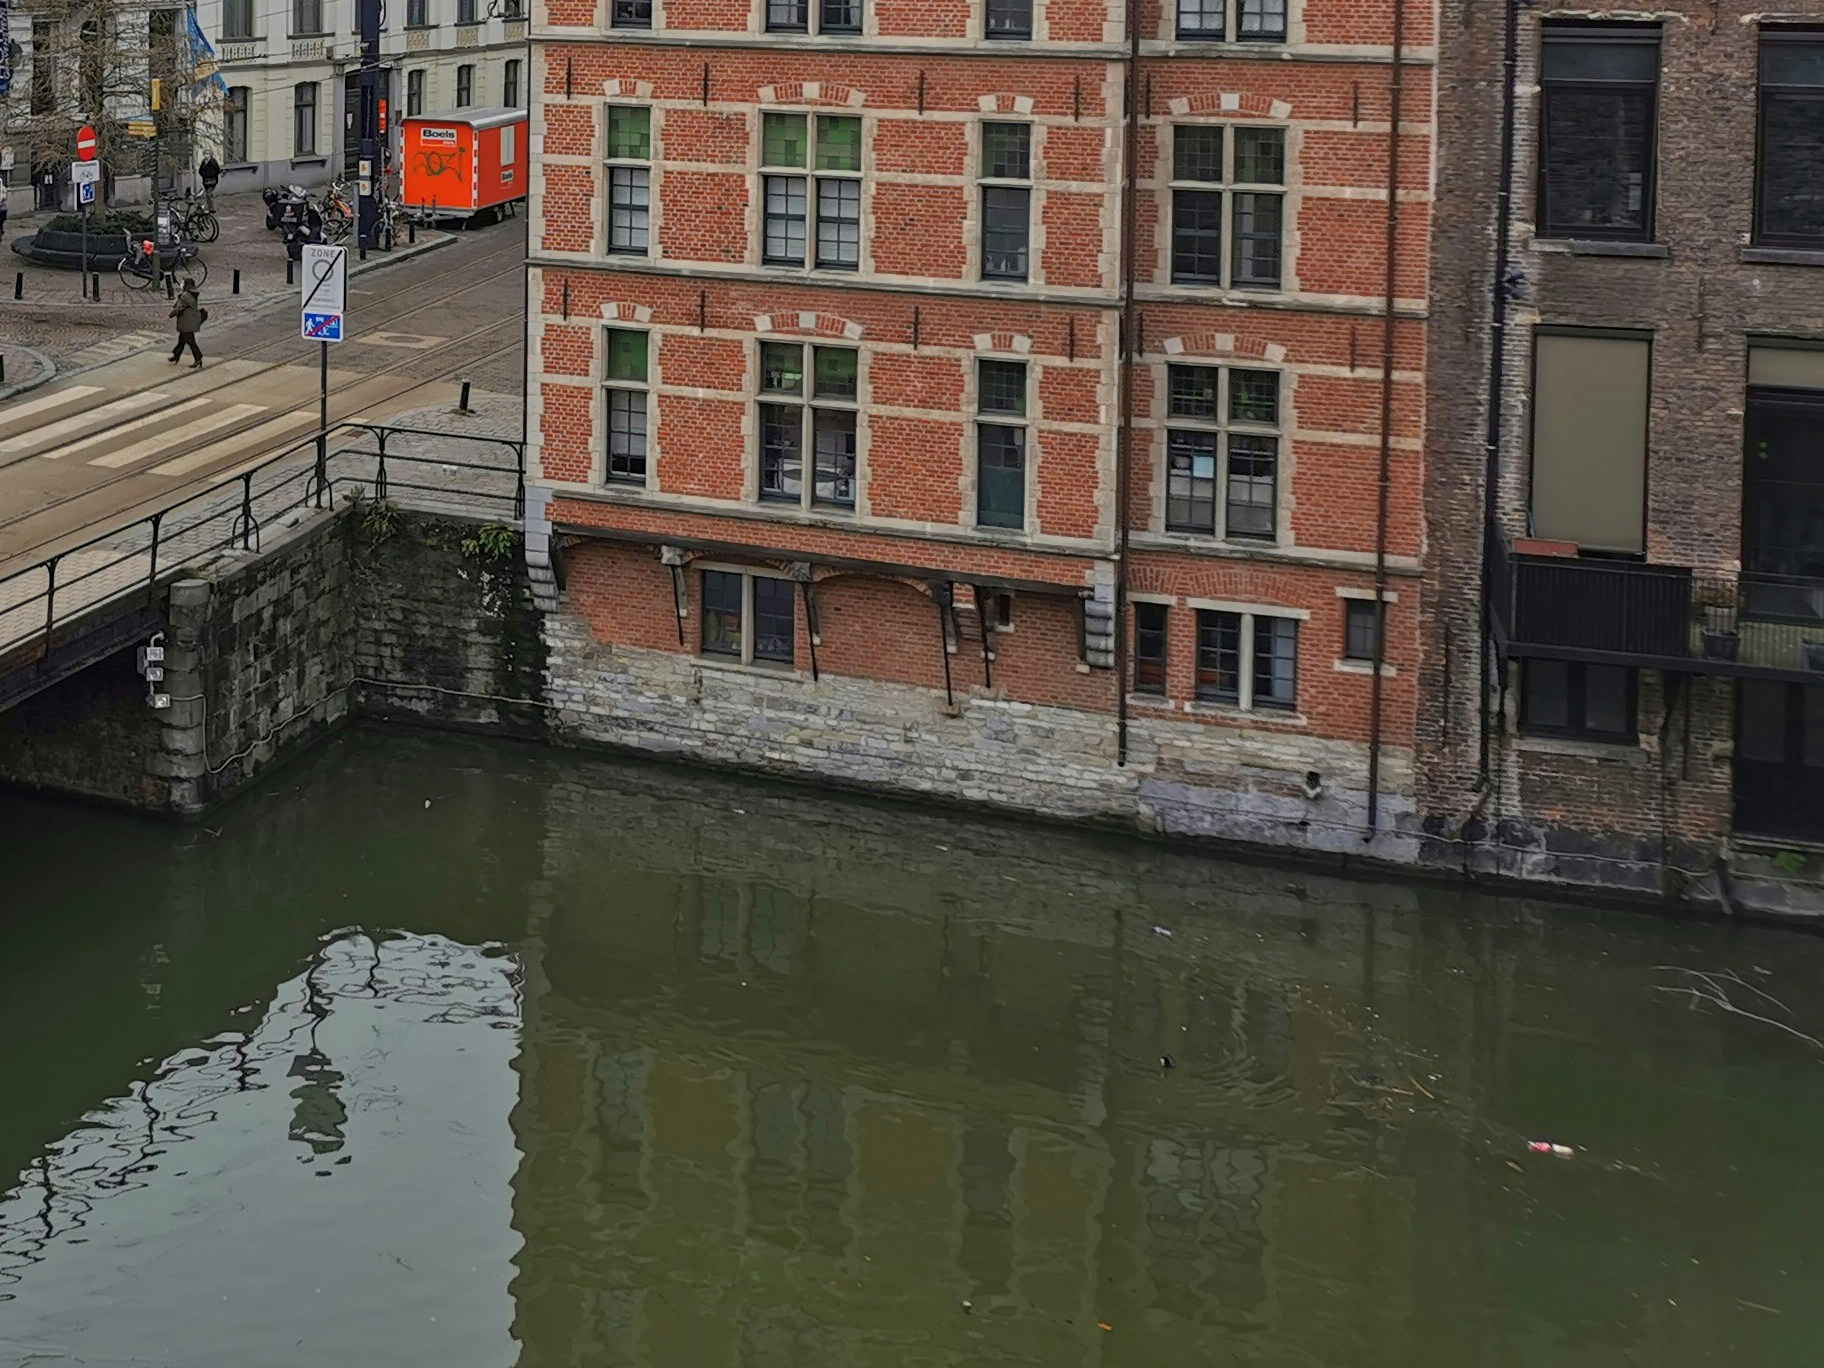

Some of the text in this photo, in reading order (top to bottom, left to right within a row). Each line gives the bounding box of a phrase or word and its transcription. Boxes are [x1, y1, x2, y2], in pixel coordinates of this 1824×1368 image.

[0, 7, 10, 79] GAVENSTEEN
[422, 129, 455, 138] Boels
[311, 248, 335, 258] ZONE
